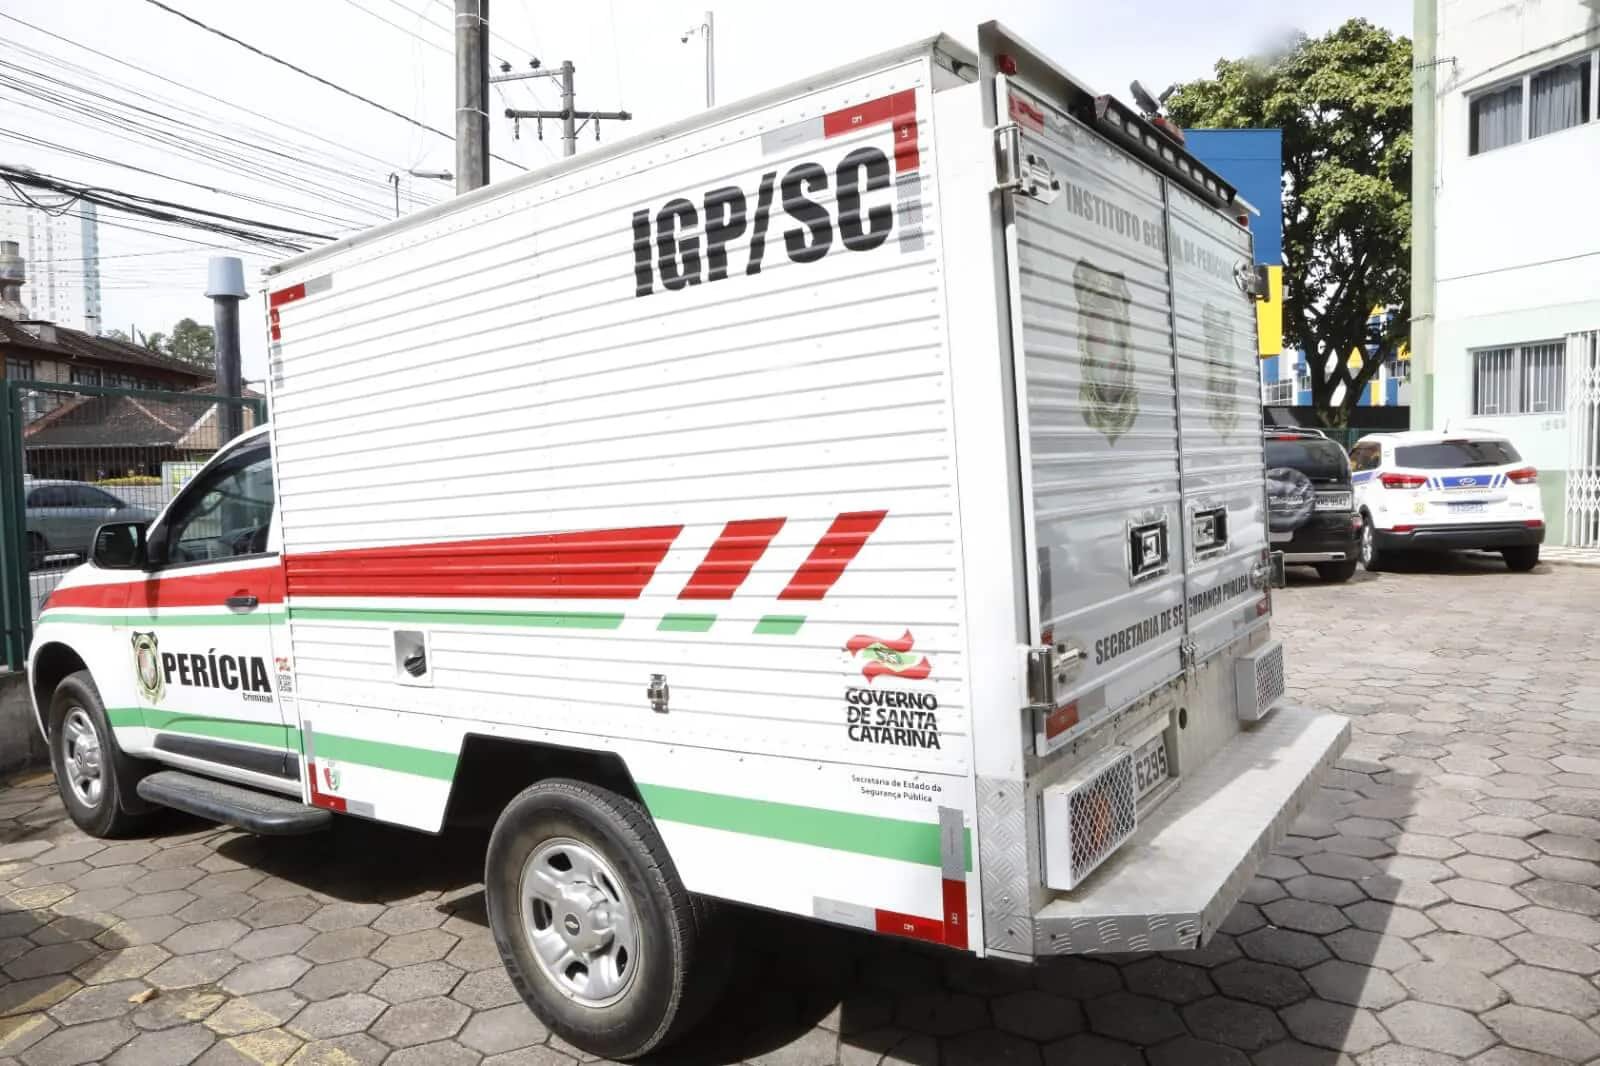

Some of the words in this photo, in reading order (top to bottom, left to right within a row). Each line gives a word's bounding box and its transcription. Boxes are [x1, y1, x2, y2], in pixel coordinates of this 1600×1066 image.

[632, 146, 893, 297] IGP/SC
[1065, 181, 1140, 242] INSTITUTO
[1095, 614, 1159, 665] SECRETARIA
[1160, 608, 1172, 633] DE
[161, 647, 272, 693] PERÍCIA
[242, 692, 273, 703] Criminal
[845, 687, 938, 711] GOVERNO
[847, 705, 871, 725] DE
[875, 708, 938, 731] SANTA
[848, 724, 941, 750] CATARINA
[1136, 744, 1167, 792] 6295
[851, 774, 889, 786] Secretaria
[891, 778, 901, 787] de
[903, 780, 930, 790] Estado
[931, 783, 942, 792] da
[860, 786, 901, 799] Segurança
[903, 791, 932, 802] Pública
